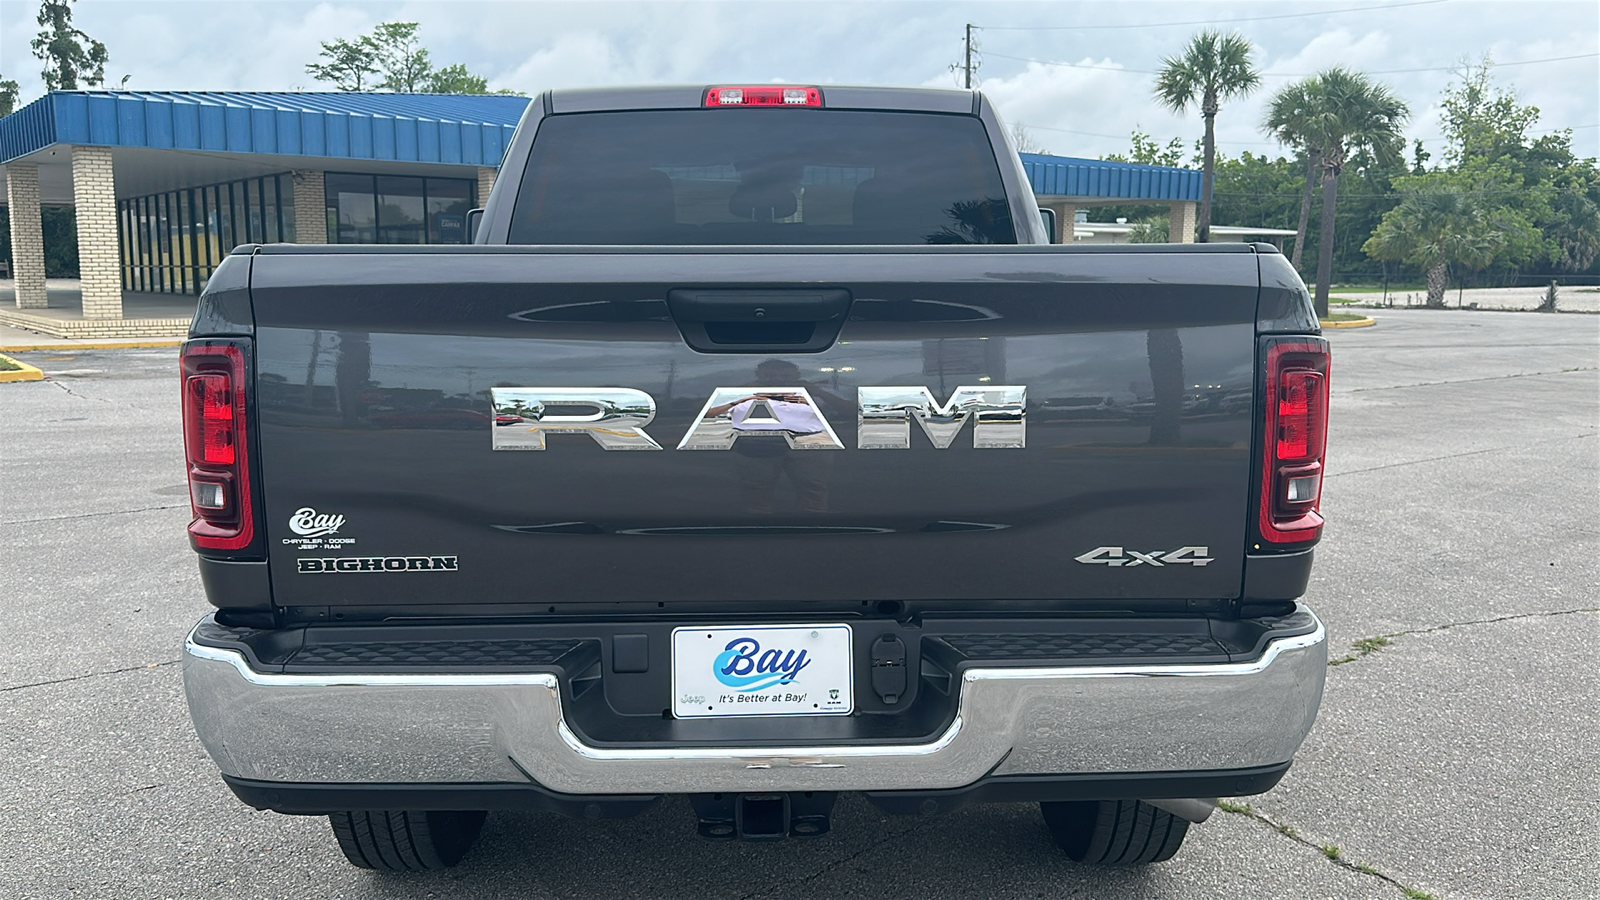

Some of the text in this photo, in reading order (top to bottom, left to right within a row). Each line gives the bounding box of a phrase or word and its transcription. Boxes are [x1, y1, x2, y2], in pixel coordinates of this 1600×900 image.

[491, 386, 1027, 451] RAM
[294, 507, 346, 534] Bay
[297, 556, 458, 573] BIGHORN
[1073, 546, 1216, 567] 4x4
[720, 637, 812, 686] Bay
[680, 694, 706, 704] Jeep
[719, 693, 807, 704] It's Better at Bay!
